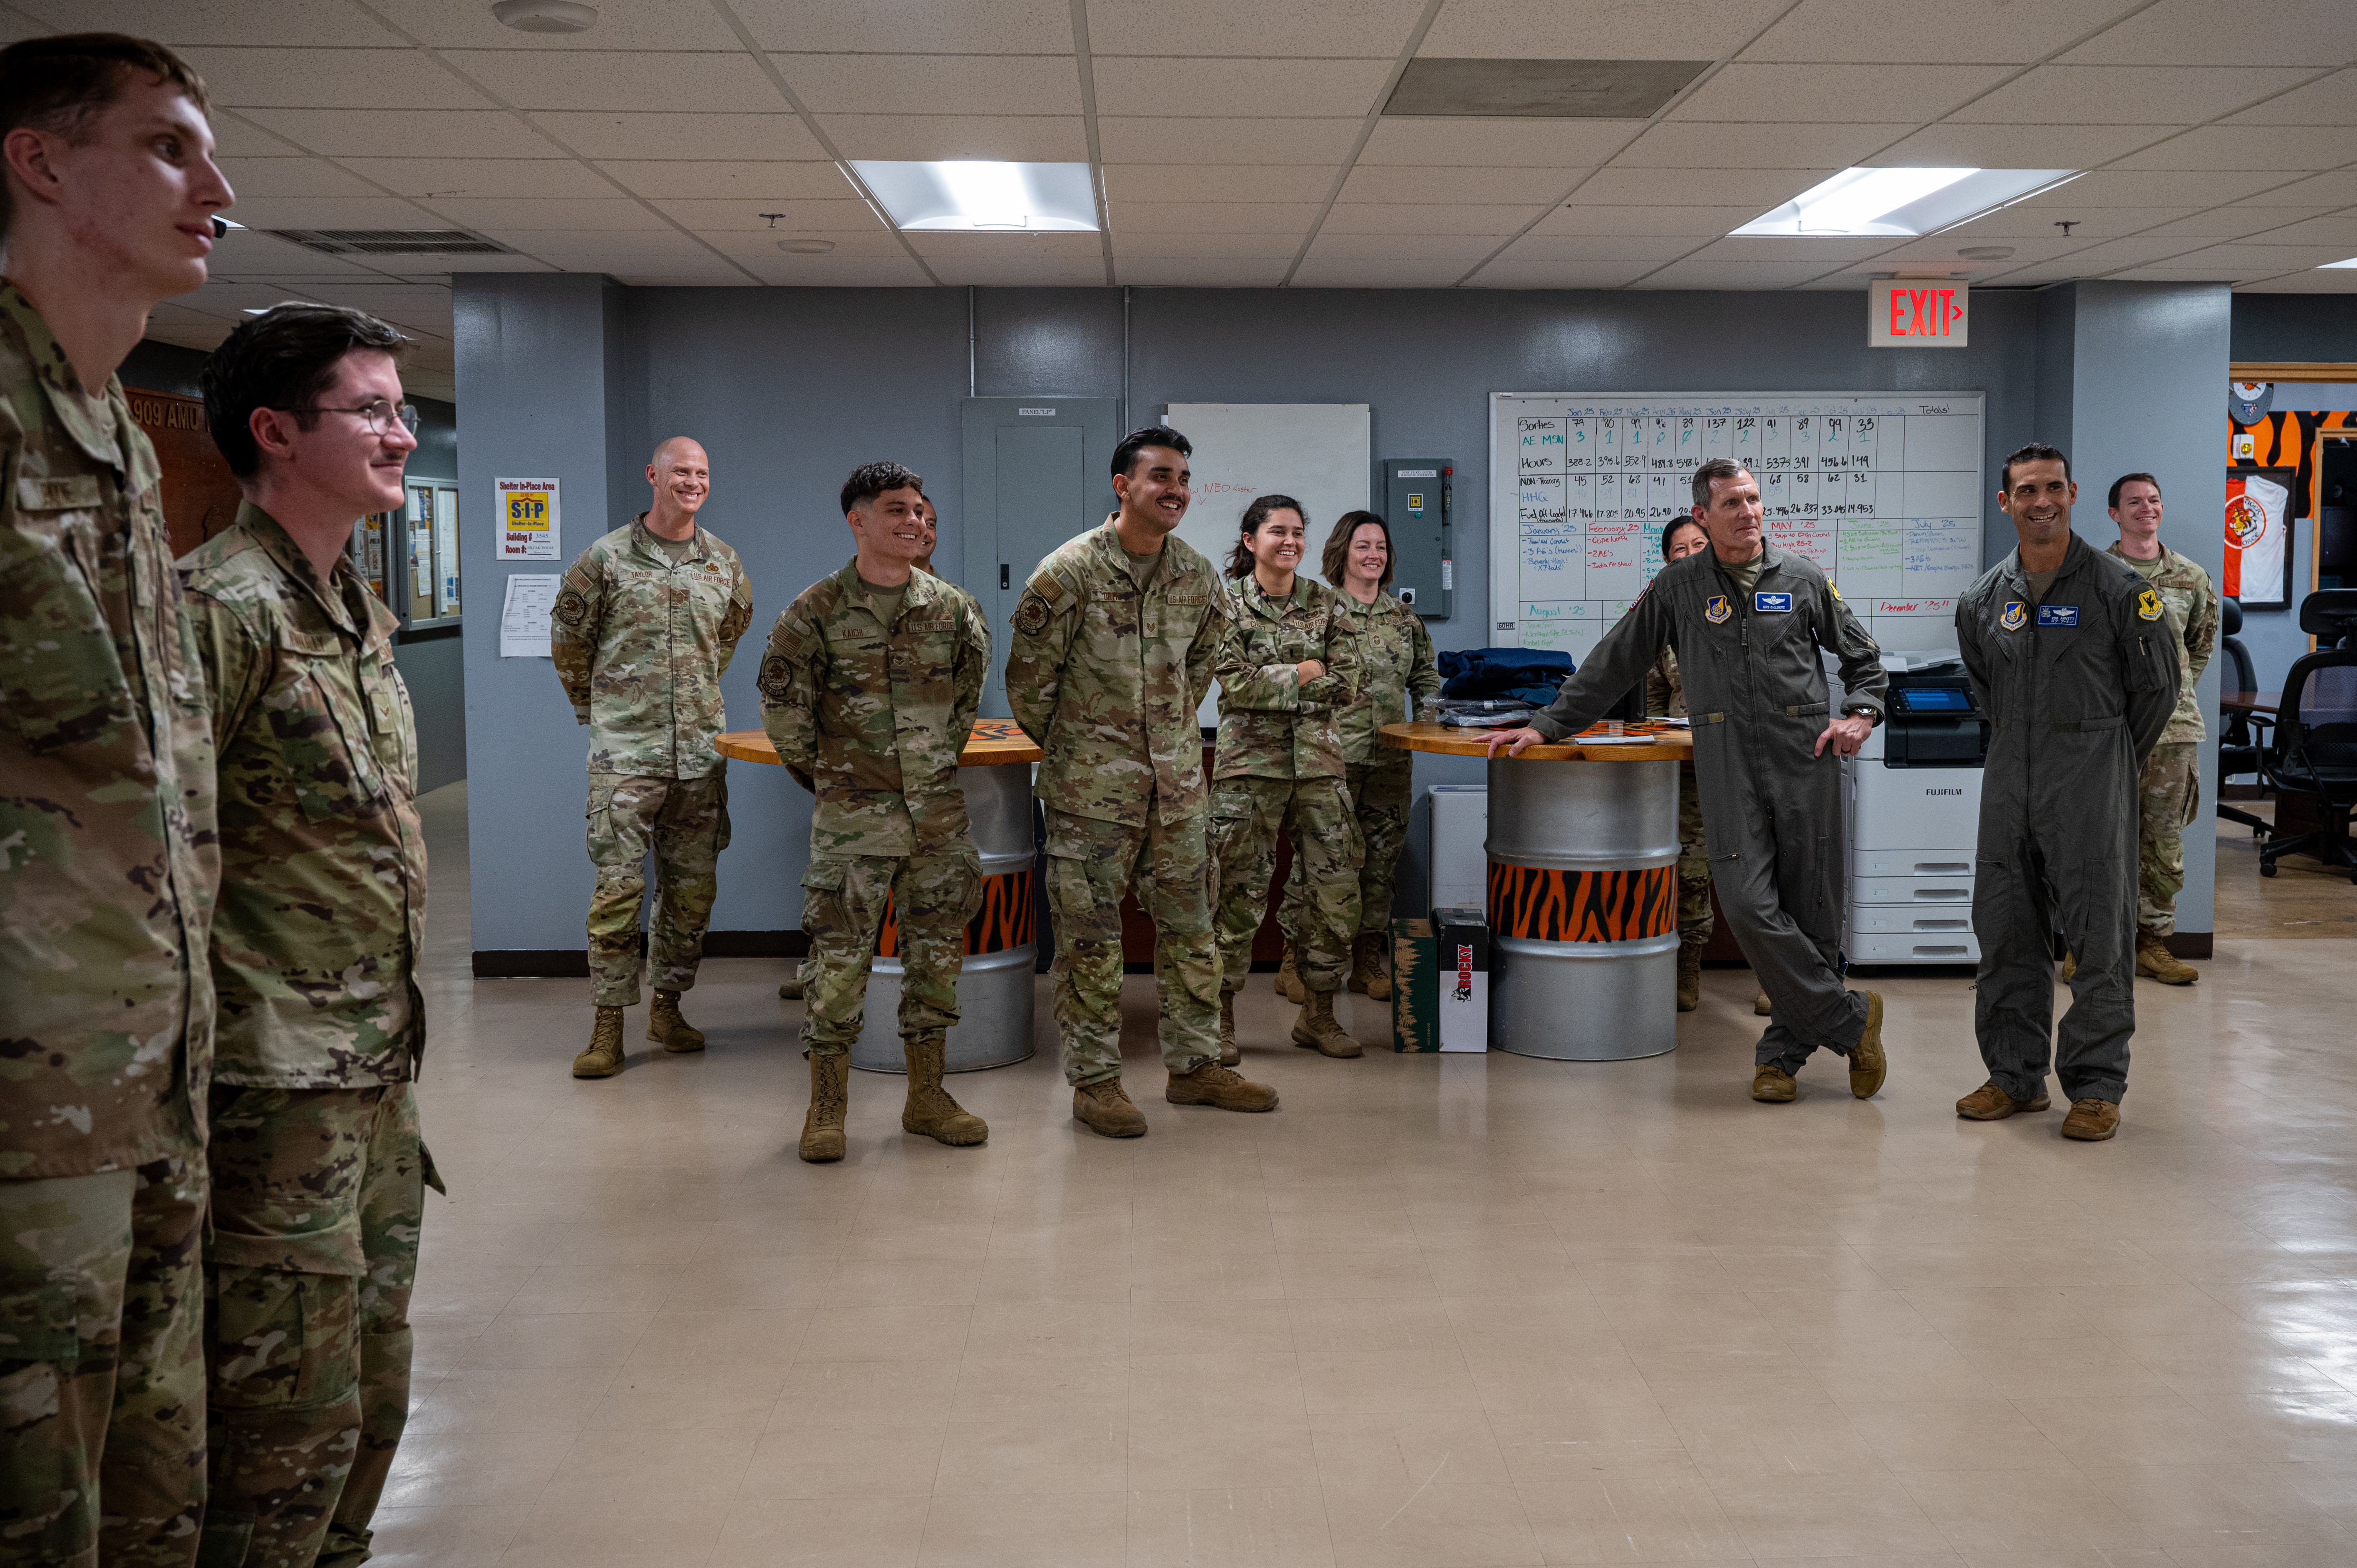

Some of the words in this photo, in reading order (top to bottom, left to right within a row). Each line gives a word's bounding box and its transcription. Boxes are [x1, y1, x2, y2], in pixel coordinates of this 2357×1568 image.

[1890, 289, 1955, 336] EXIT
[134, 399, 161, 427] 909
[167, 404, 198, 430] AMU
[1626, 407, 1639, 416] Mar
[1735, 407, 1752, 416] July
[1919, 404, 1950, 415] Totals!
[1519, 419, 1555, 432] Sorties
[1603, 418, 1615, 428] 80
[1683, 418, 1694, 428] 89
[1708, 418, 1726, 428] 137
[1737, 418, 1756, 430] 122
[1767, 419, 1776, 429] 91
[1797, 418, 1809, 430] 89
[1857, 418, 1874, 433] 33
[1522, 435, 1537, 446] AE
[1542, 435, 1564, 445] MSN
[1576, 431, 1585, 443] 3
[1605, 430, 1613, 444] 1
[1632, 431, 1642, 444] 1
[1710, 430, 1720, 444] 2
[1740, 430, 1749, 443] 2
[1769, 428, 1778, 440] 3
[1801, 431, 1810, 442] 3
[1829, 432, 1839, 442] 2
[1859, 431, 1870, 443] 1
[1522, 458, 1552, 469] Hours
[1794, 456, 1809, 469] 391
[1852, 455, 1869, 467] 149
[500, 481, 518, 490] Shelter
[520, 482, 541, 490] In-Place
[542, 482, 555, 490] Area
[1520, 477, 1560, 487] NON-Training
[1574, 476, 1587, 486] 45
[1601, 475, 1614, 485] 52
[1629, 475, 1641, 484] 68
[1653, 476, 1665, 486] 41
[1770, 474, 1782, 485] 68
[1797, 474, 1809, 483] 58
[1828, 474, 1840, 482] 62
[1854, 474, 1867, 483] 31
[1204, 483, 1230, 493] NEO
[1522, 491, 1548, 502] HHQ
[1520, 508, 1537, 520] Fuel
[1522, 524, 1560, 536] January
[1588, 523, 1625, 537] February
[1771, 521, 1792, 531] MAY
[1911, 519, 1931, 530] July
[506, 533, 527, 543] Building
[505, 545, 520, 554] Room
[521, 545, 527, 554] #:
[714, 577, 730, 586] FORCE
[1529, 604, 1561, 619] August
[1880, 602, 1919, 612] December
[924, 622, 935, 631] AIR
[935, 621, 954, 631] FORCE
[842, 629, 863, 638] KAICHI
[1458, 944, 1473, 989] ROCKY
